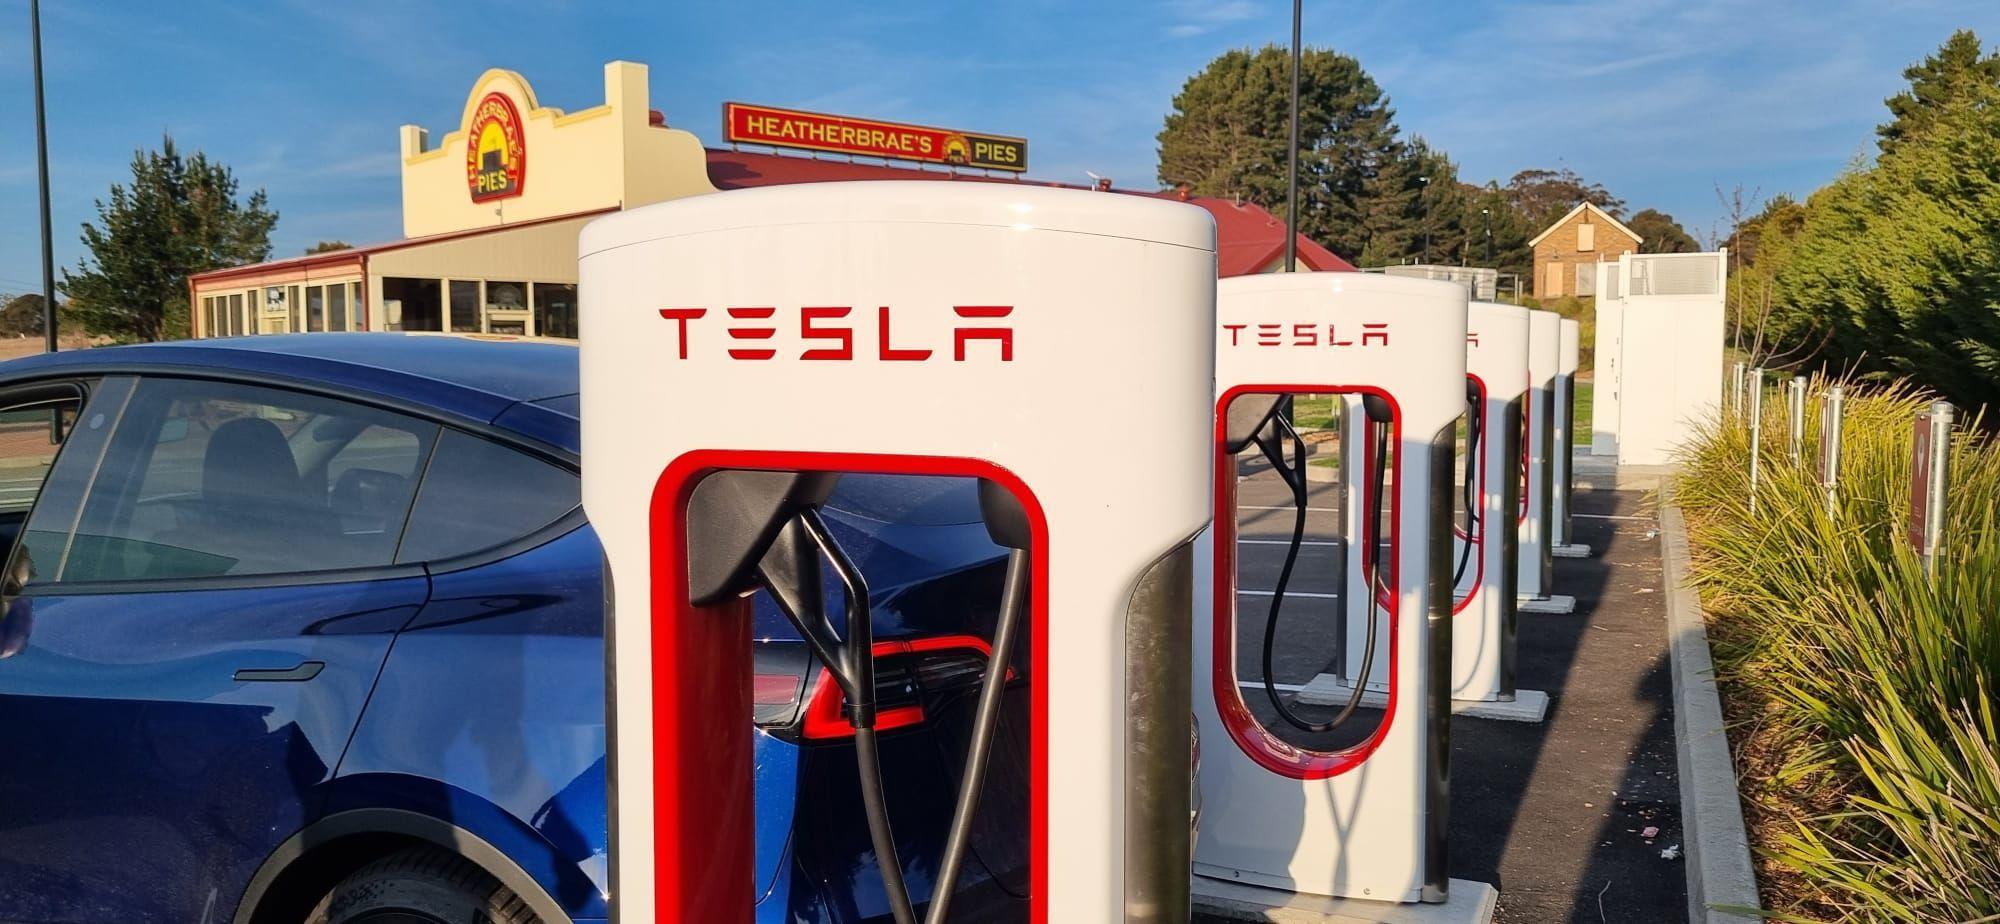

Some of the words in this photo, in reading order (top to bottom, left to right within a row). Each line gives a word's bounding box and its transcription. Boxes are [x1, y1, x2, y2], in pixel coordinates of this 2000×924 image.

[747, 115, 932, 153] HEATHERBRAE'S
[975, 141, 1017, 162] PIES
[478, 169, 507, 193] PIES
[659, 306, 1014, 361] TESLA
[1222, 324, 1388, 347] TESLA
